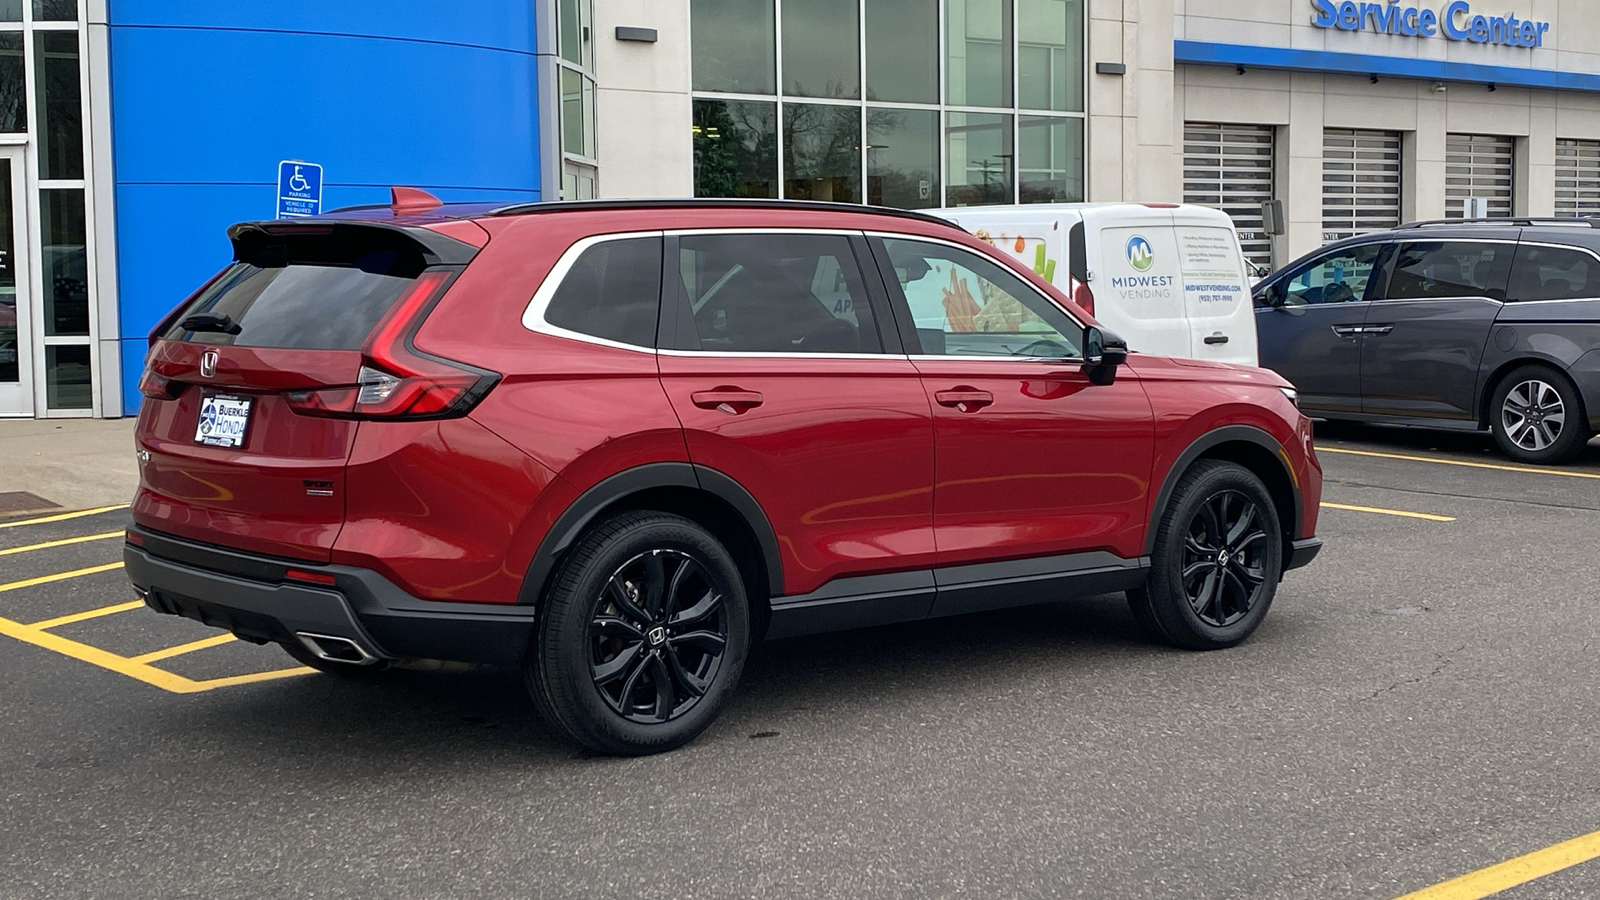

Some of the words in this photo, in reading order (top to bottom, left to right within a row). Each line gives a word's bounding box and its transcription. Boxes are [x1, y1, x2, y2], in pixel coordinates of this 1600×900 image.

[1311, 0, 1436, 37] Service
[1441, 0, 1550, 48] Center
[285, 200, 306, 208] VEHICLE
[286, 206, 312, 214] REQUIRED
[1112, 276, 1173, 288] MIDWEST
[1185, 284, 1241, 292] MIDWESTVENDING.COM
[1119, 289, 1171, 300] VENDING
[833, 299, 854, 314] AP
[215, 416, 246, 435] HONDA
